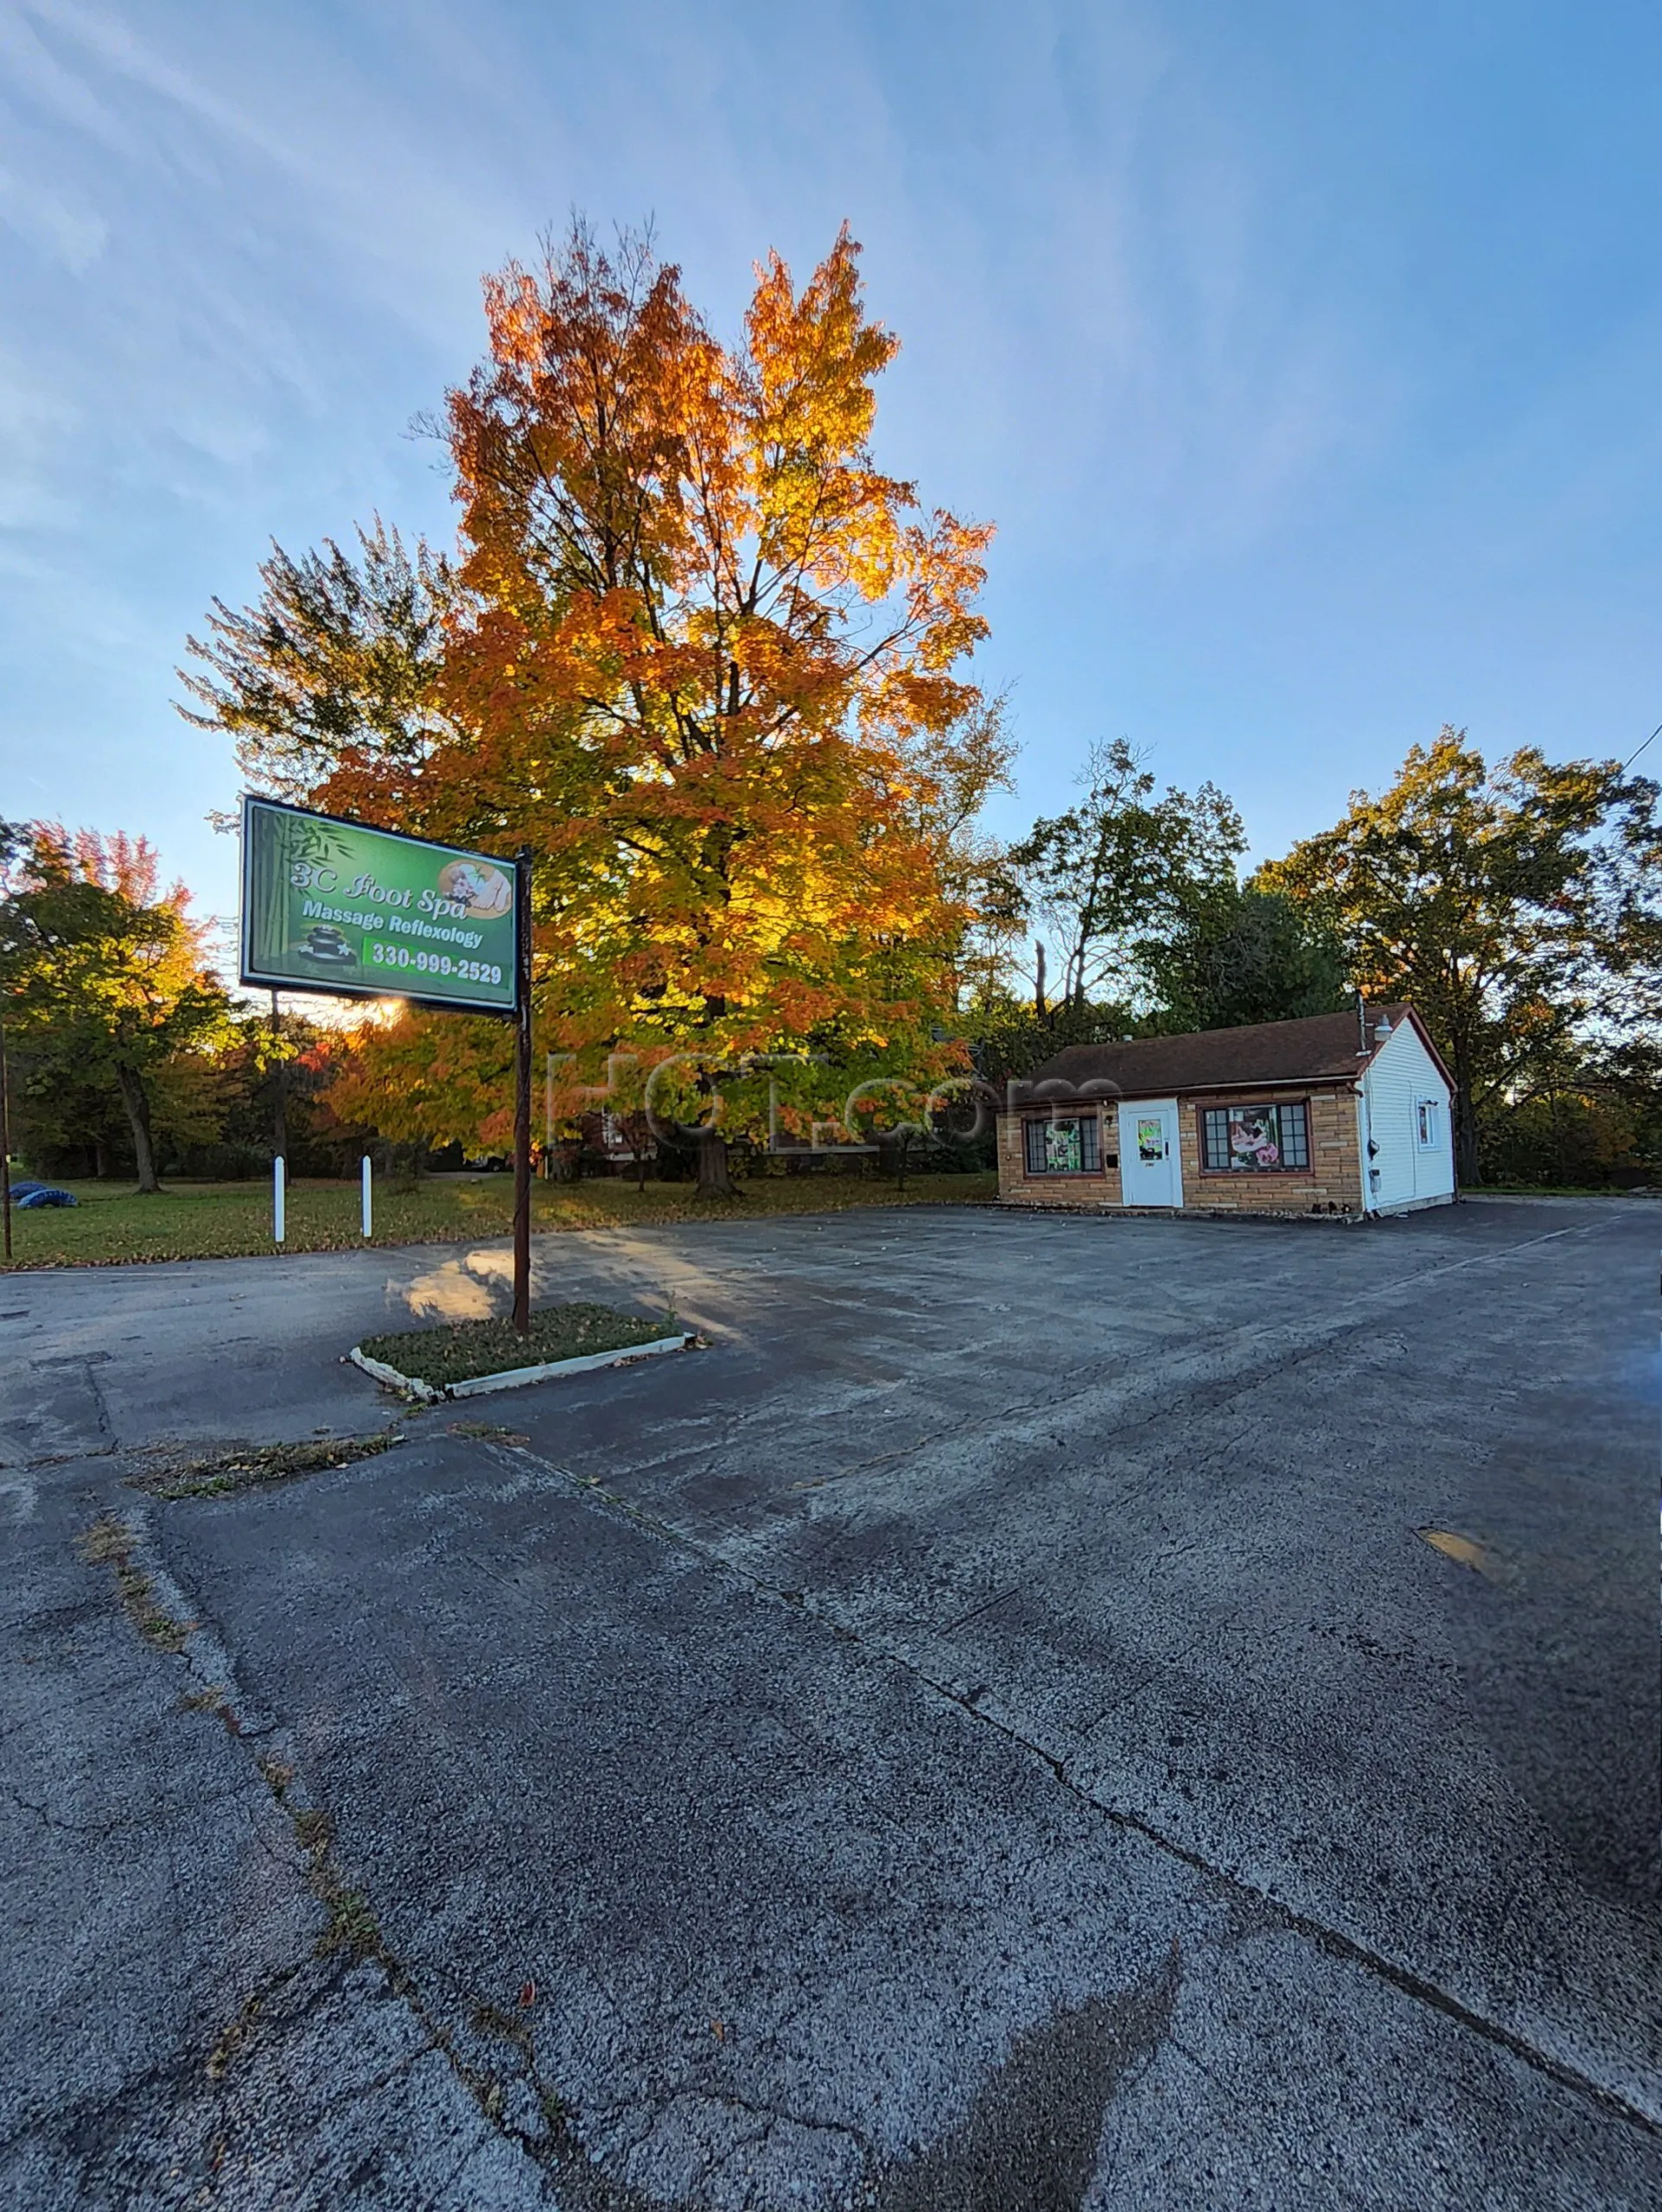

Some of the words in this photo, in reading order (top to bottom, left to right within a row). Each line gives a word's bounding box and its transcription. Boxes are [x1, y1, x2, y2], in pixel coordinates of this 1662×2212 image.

[291, 862, 337, 892] 3C
[345, 873, 413, 907] Foot
[417, 889, 468, 921] Spa
[302, 900, 384, 931] Massage
[390, 916, 483, 950] Reflexology
[373, 943, 501, 985] 330-999-2529
